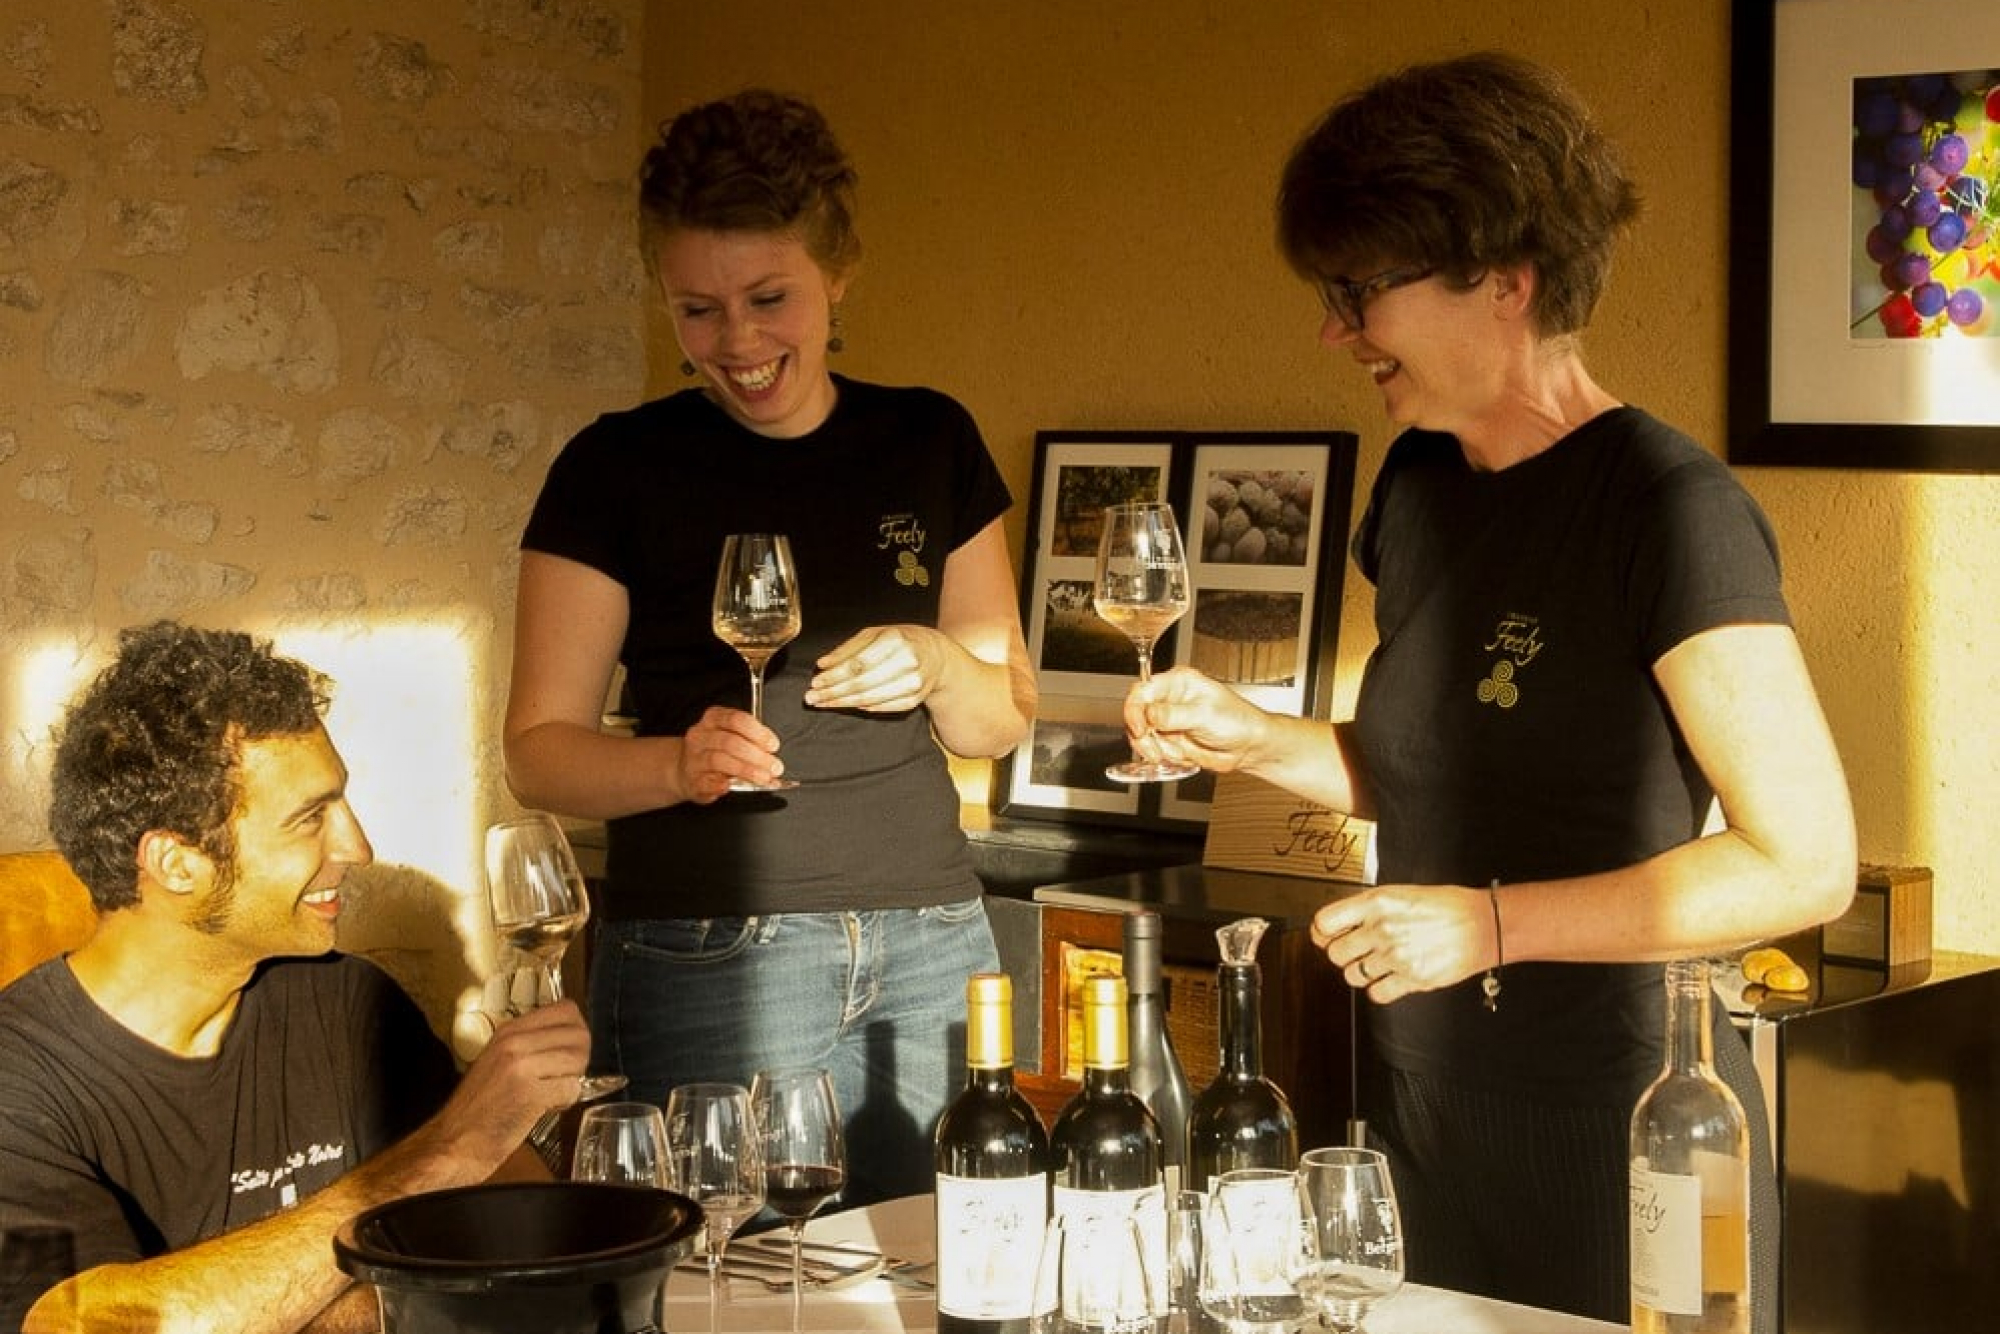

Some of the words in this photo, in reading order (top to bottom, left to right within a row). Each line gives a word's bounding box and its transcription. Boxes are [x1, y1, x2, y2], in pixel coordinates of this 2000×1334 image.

[878, 519, 926, 553] Feely
[1484, 621, 1543, 667] Feely
[1273, 811, 1357, 871] Feely
